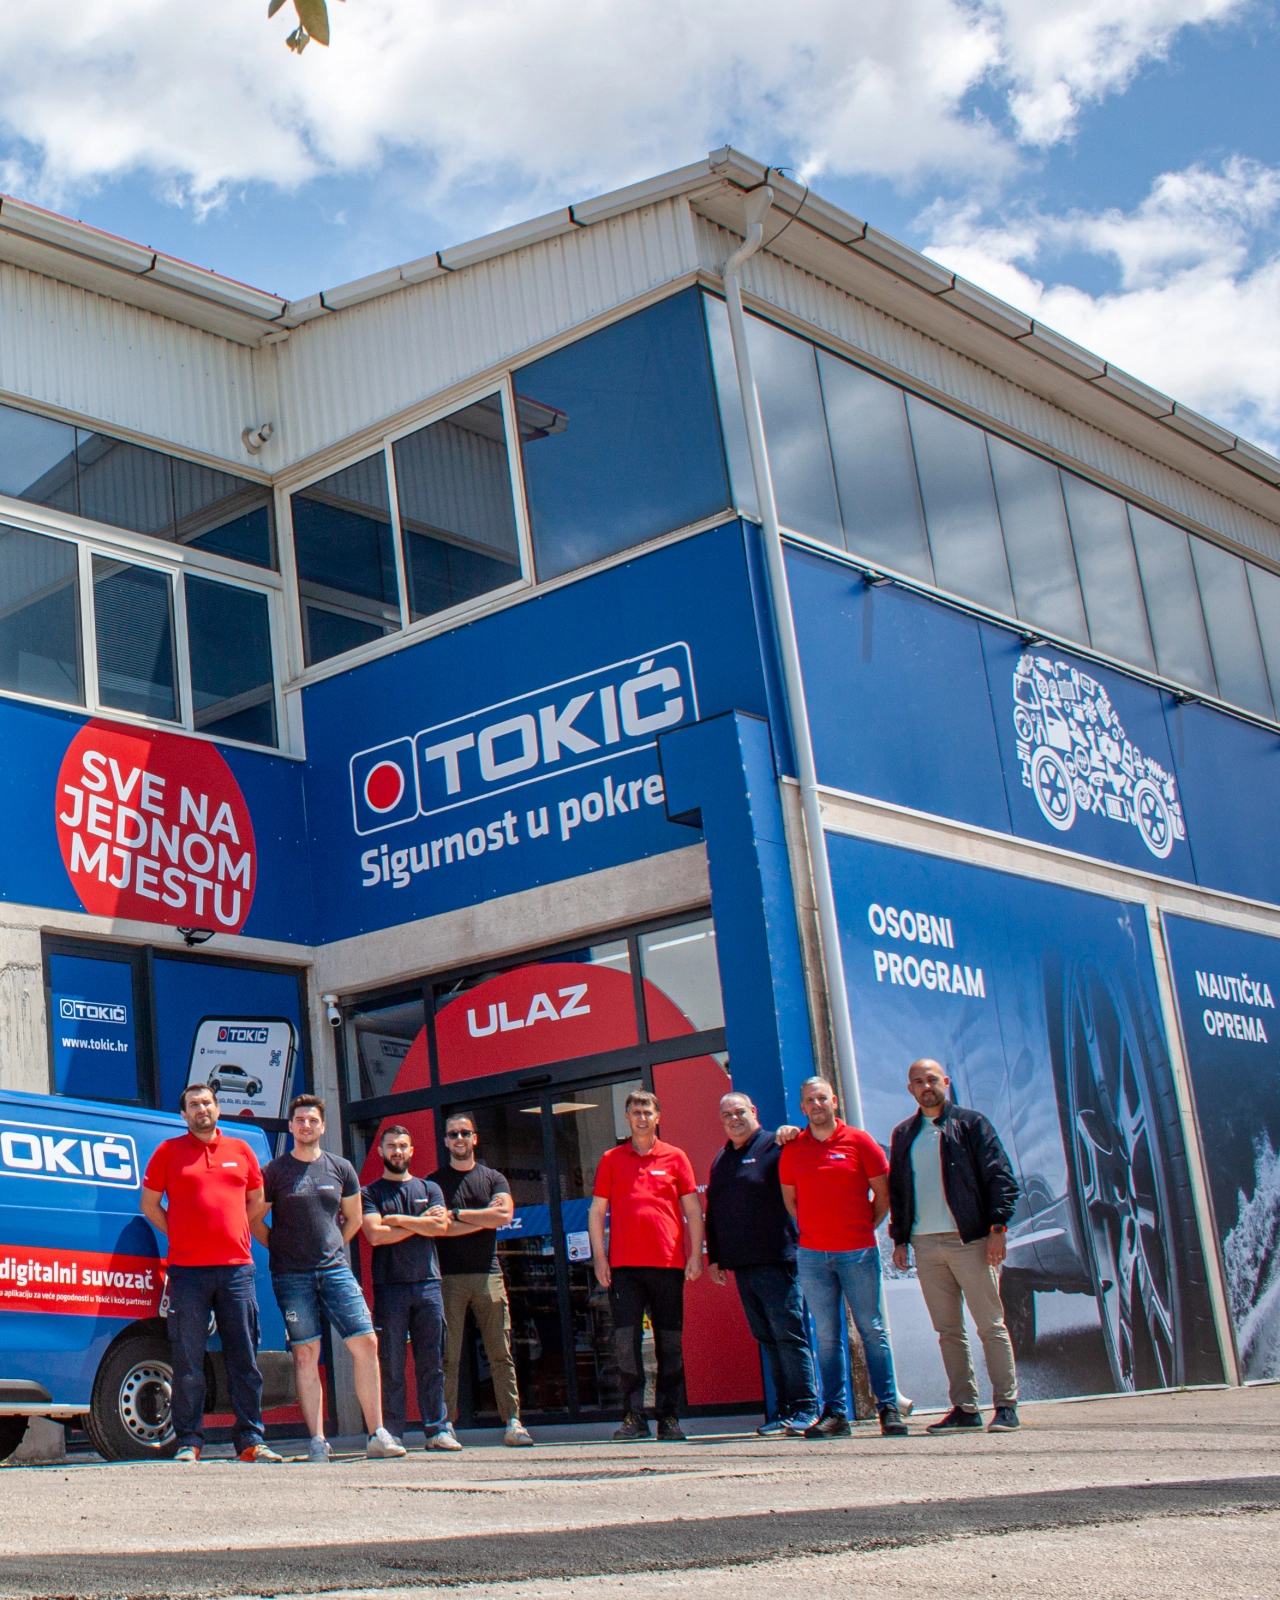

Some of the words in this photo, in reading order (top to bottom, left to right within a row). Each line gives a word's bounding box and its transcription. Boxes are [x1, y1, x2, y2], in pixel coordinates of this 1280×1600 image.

[425, 659, 684, 796] TOKIĆ
[81, 749, 164, 814] SVE
[181, 785, 241, 845] NA
[60, 784, 251, 891] JEDNOM
[361, 811, 520, 889] Sigurnost
[527, 804, 551, 839] u
[559, 774, 665, 842] pokre
[71, 834, 241, 926] MJESTU
[868, 903, 955, 949] OSOBNI
[873, 950, 986, 998] PROGRAM
[1195, 971, 1275, 1009] NAUTIČKA
[75, 1004, 125, 1021] TOKIĆ
[467, 983, 591, 1038] ULAZ
[1203, 1009, 1268, 1043] OPREMA
[62, 1037, 128, 1052] www.tokic.hr
[230, 1028, 267, 1042] TOKIĆ
[4, 1289, 32, 1300] aplikaciju
[42, 1291, 56, 1300] veće
[56, 1293, 89, 1303] pogodnosti
[125, 1298, 152, 1307] partnera!
[82, 1269, 154, 1290] suvozač
